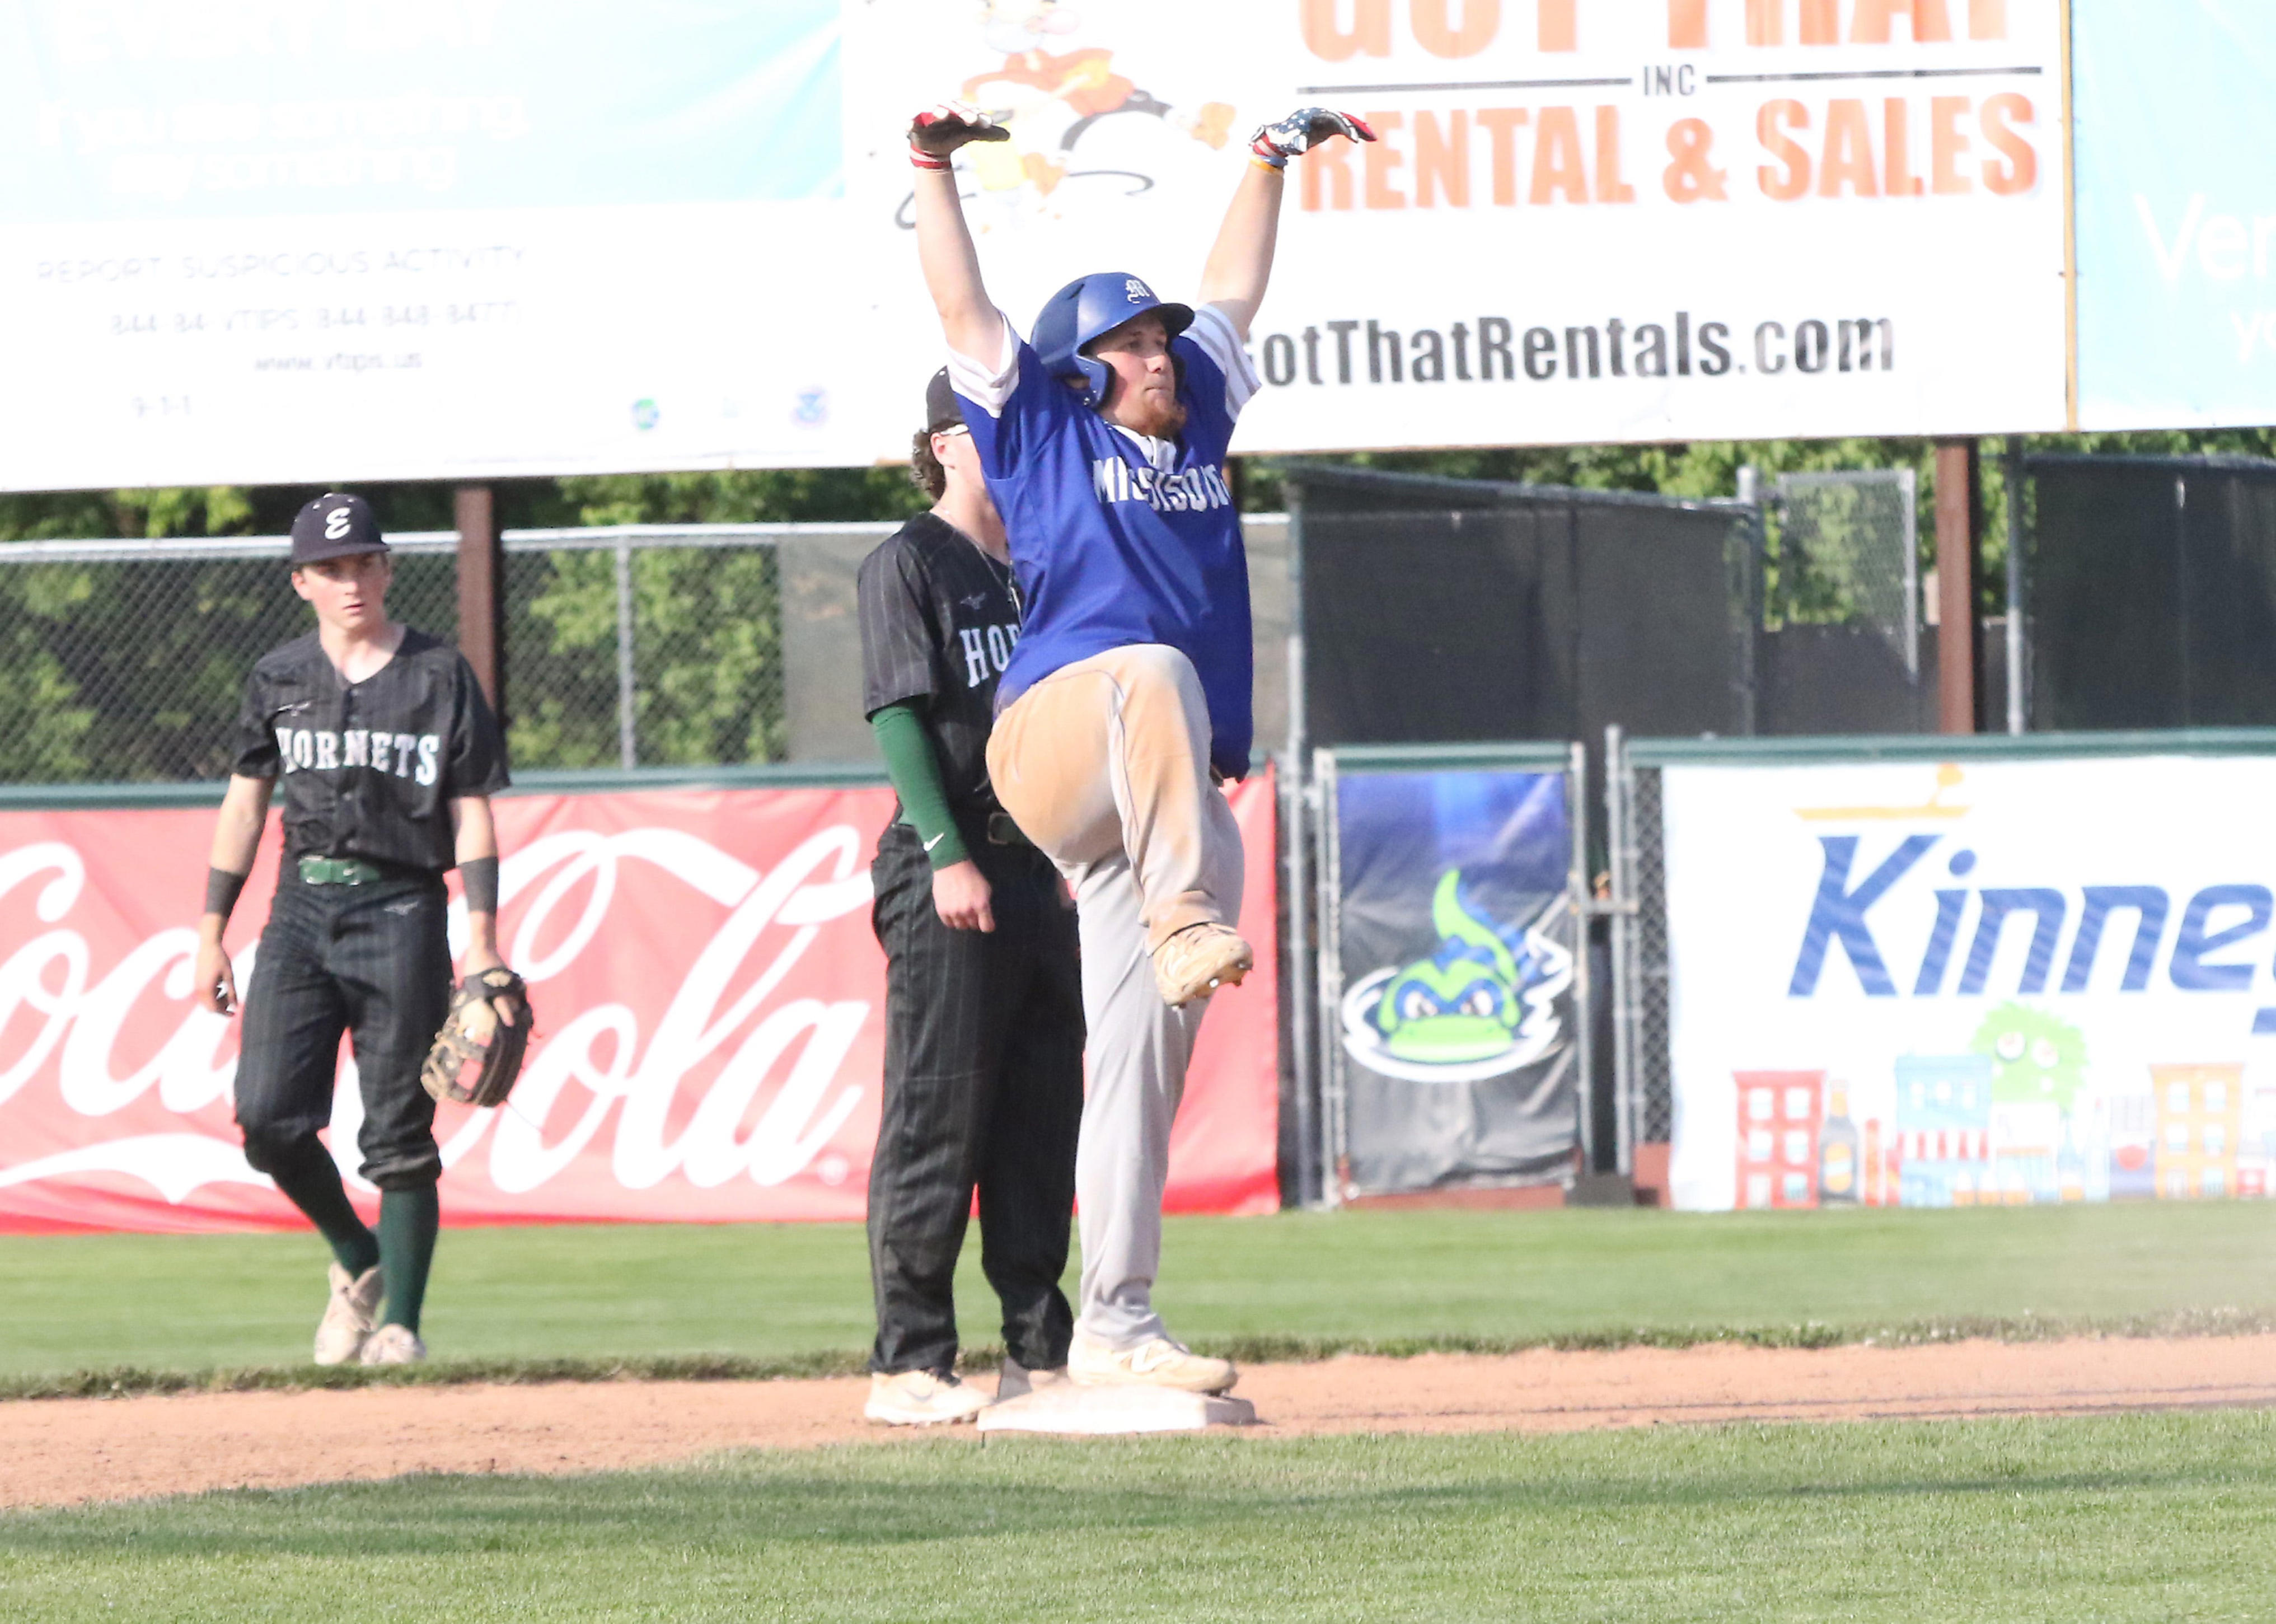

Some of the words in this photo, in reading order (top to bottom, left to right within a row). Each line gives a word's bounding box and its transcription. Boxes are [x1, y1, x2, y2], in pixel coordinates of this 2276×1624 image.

[1643, 64, 1696, 96] INC
[1300, 105, 1636, 212] RENTAL
[1662, 117, 1729, 205] &
[1755, 92, 2039, 202] SALES
[37, 256, 163, 283] REPORT
[180, 251, 370, 279] SUSPICIOUS
[383, 245, 527, 273] ACTIVITY
[1243, 311, 1893, 387] otThatRentals.com
[275, 728, 439, 786] HORNETS
[1788, 834, 2276, 1033] Kinne
